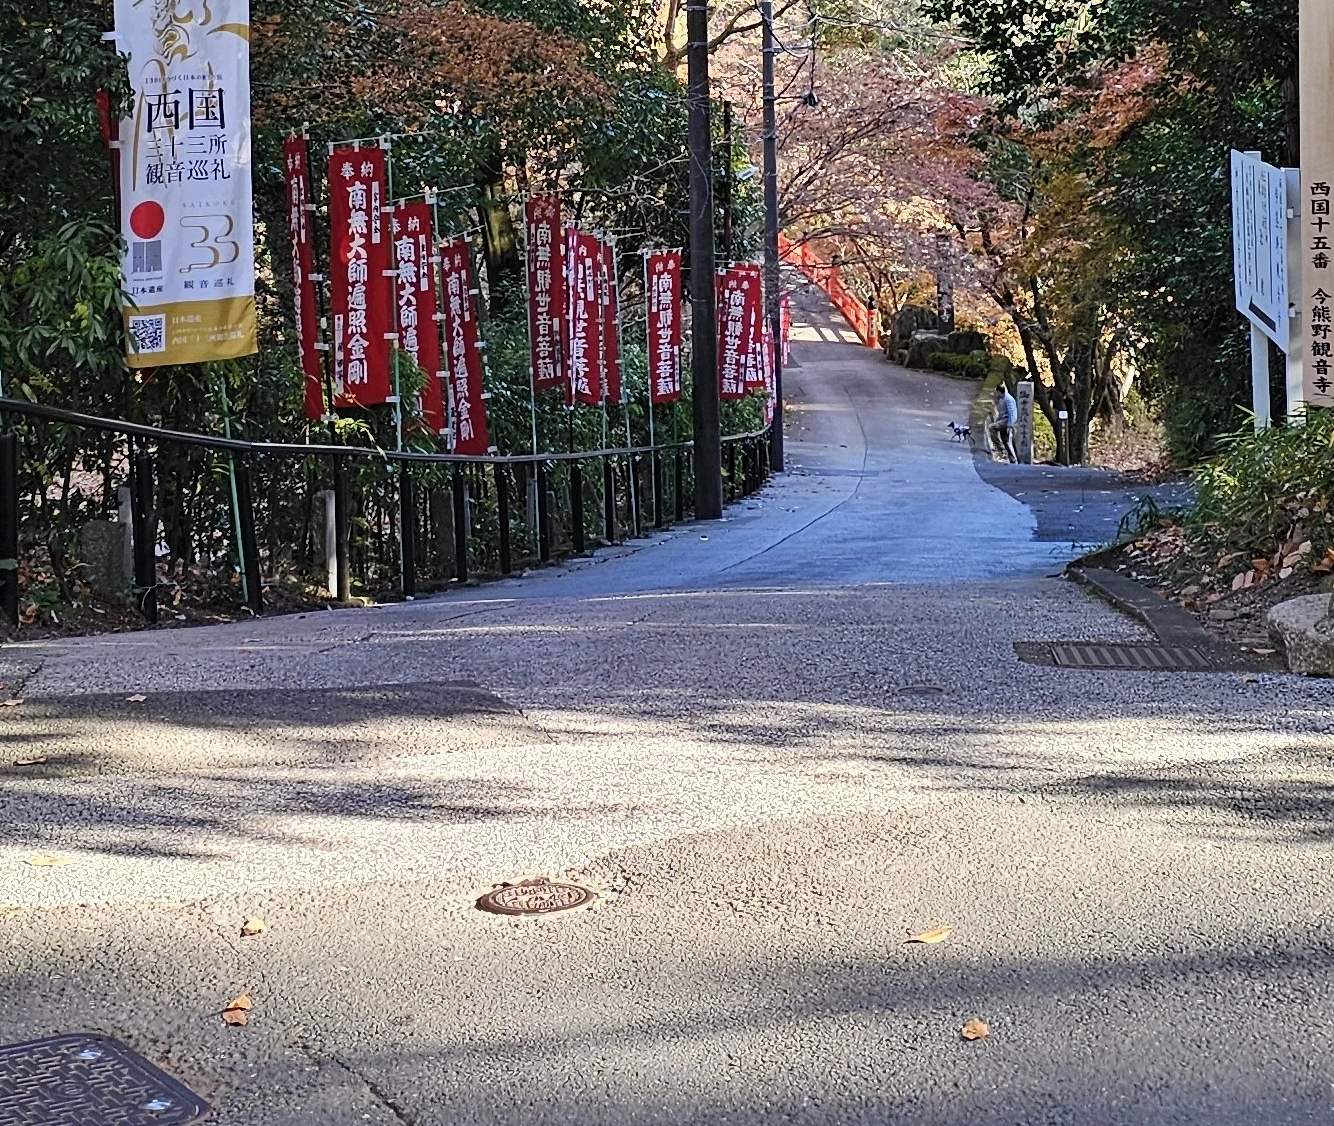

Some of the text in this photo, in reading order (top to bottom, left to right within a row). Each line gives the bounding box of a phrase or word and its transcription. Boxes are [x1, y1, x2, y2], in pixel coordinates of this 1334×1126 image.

[146, 88, 226, 133] 西国
[145, 134, 227, 158] 三十三所
[146, 158, 231, 185] 観音巡礼
[340, 160, 374, 180] 奉納
[388, 216, 420, 234] 奉納
[442, 253, 462, 273] 奉納
[183, 278, 235, 290] 観音巡礼
[346, 181, 369, 385] 南無大師遍照金剛
[1309, 181, 1333, 394] 西国十五番 今熊野観音寺
[446, 271, 474, 442] 南無大師遍照金剛
